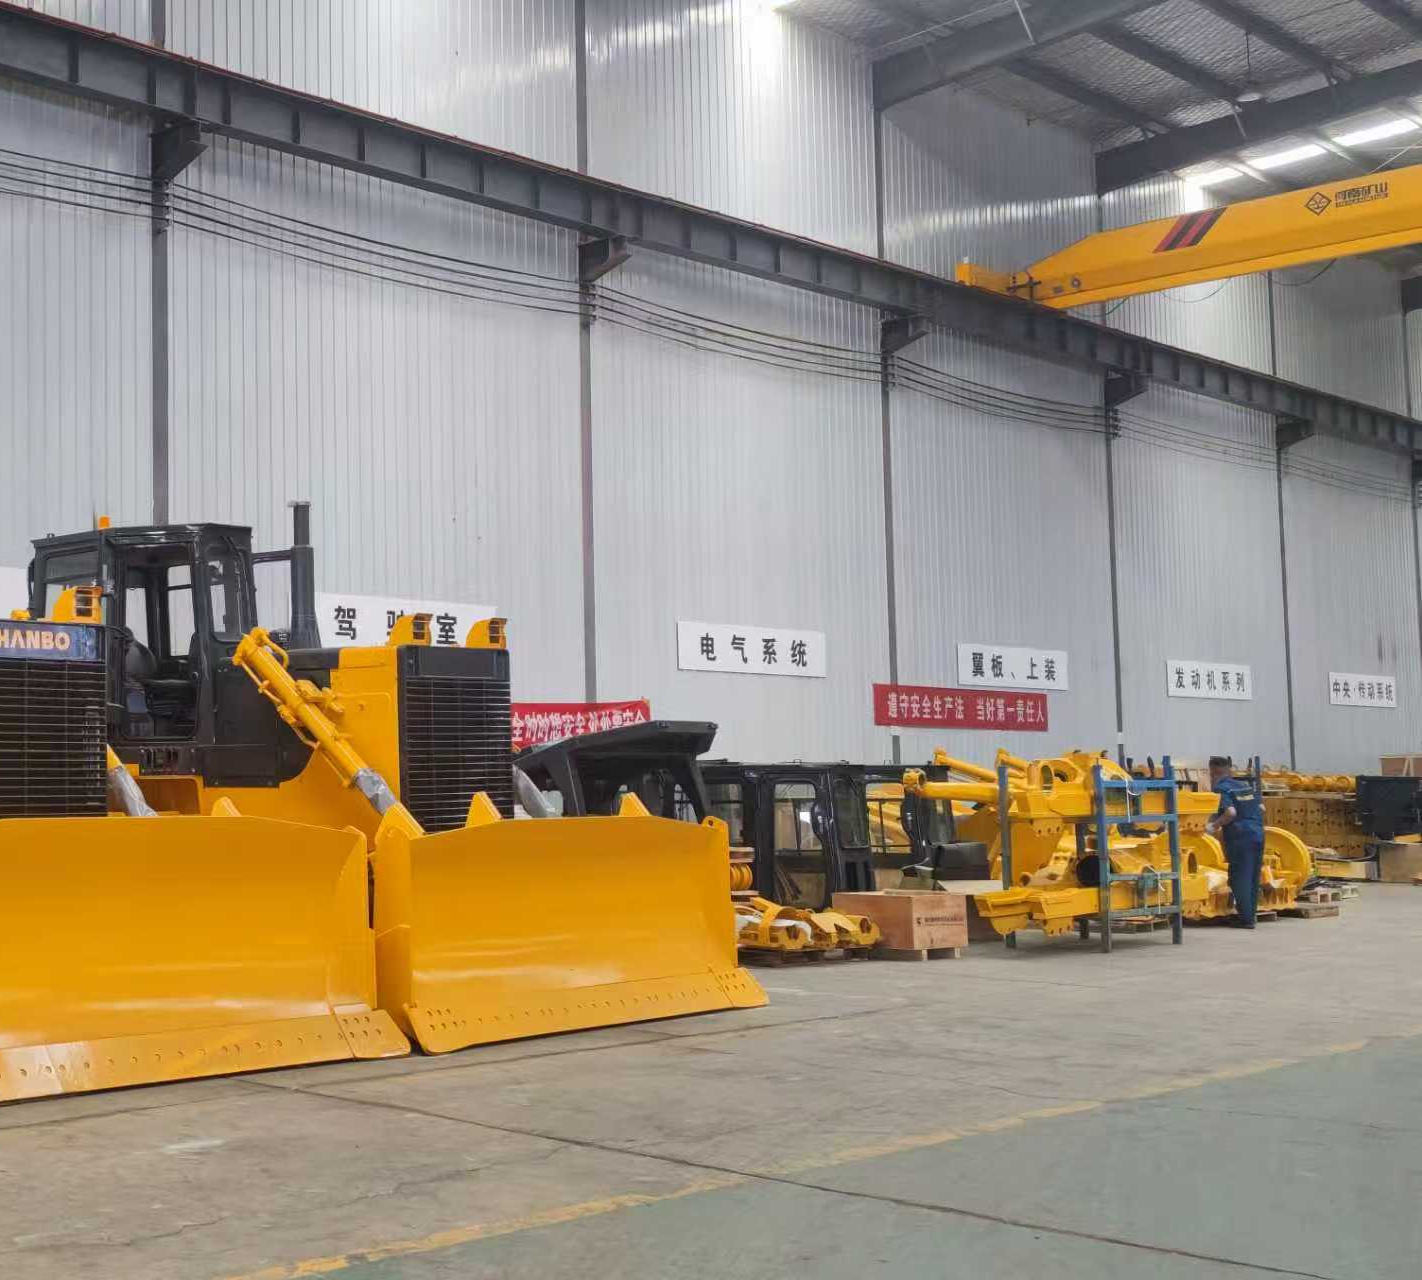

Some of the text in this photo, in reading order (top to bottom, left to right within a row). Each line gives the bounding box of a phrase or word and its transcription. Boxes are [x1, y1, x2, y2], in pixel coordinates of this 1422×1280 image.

[700, 632, 808, 667] 电气系统
[1175, 666, 1245, 692] 发动机系列
[888, 692, 1045, 722] 遵守安全生产法 当好第一责任人
